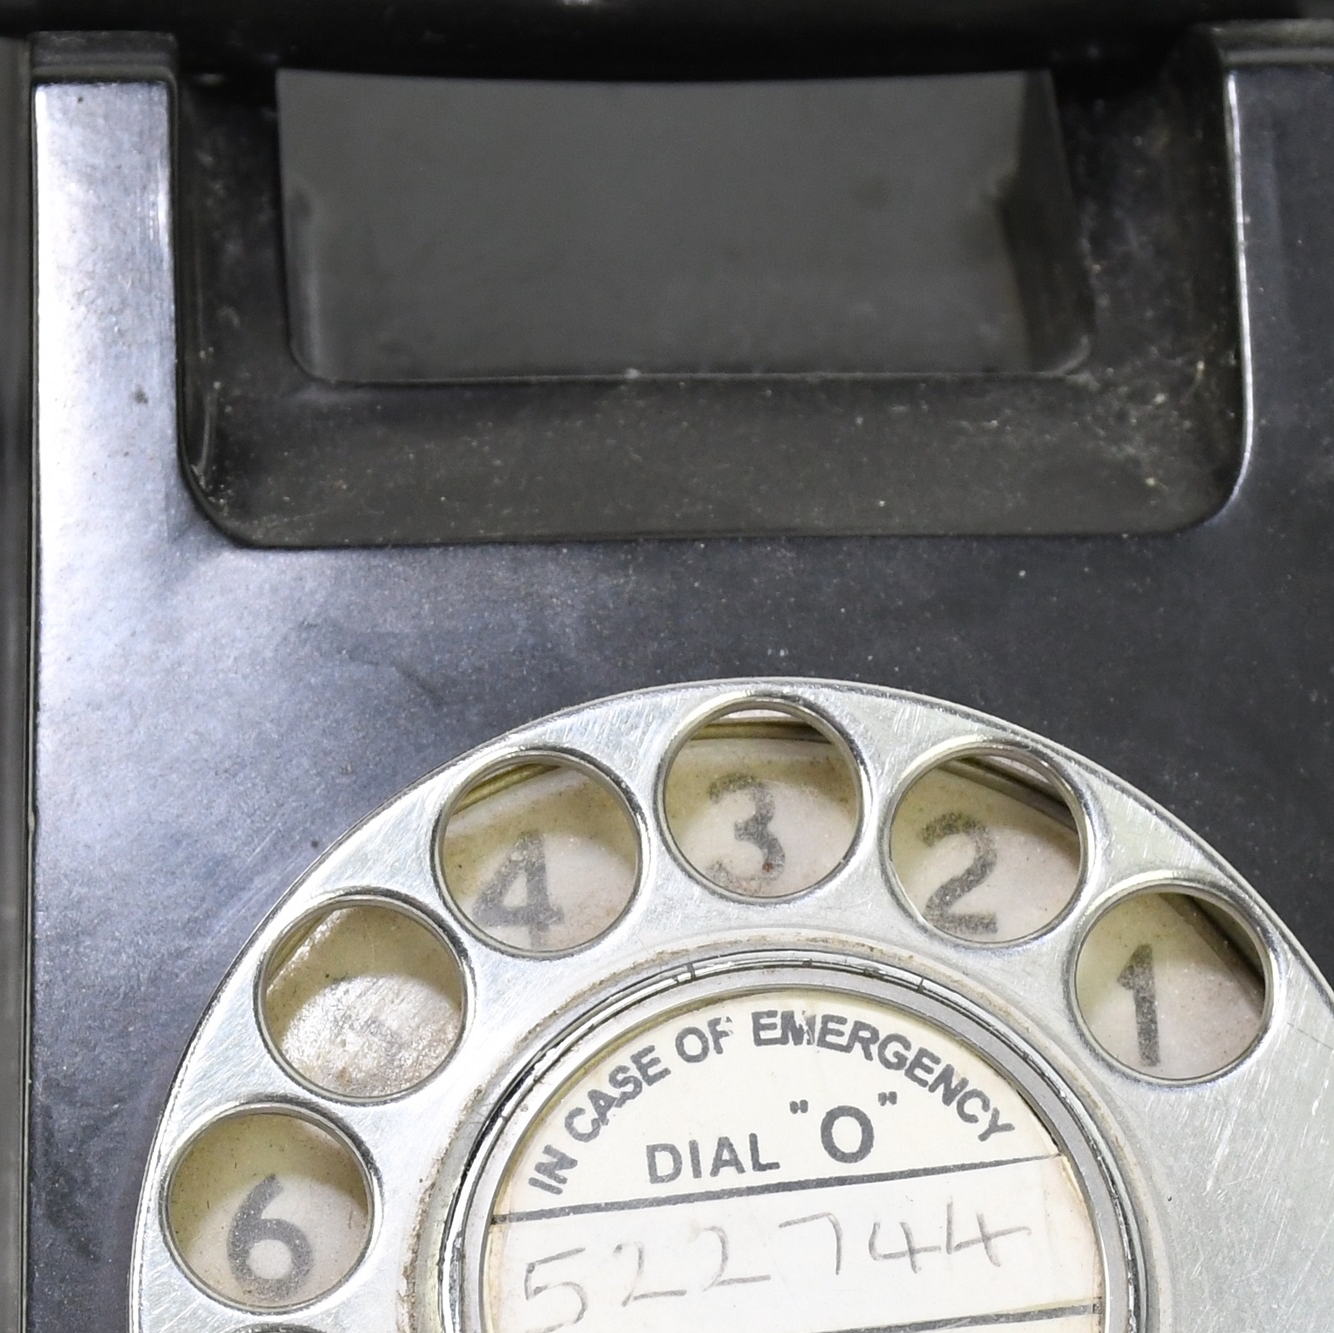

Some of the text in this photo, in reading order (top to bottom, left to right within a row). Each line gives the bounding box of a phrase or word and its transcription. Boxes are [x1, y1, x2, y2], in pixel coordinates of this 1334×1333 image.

[473, 827, 563, 948] 4
[708, 773, 786, 886] 3
[920, 814, 998, 935] 2
[1116, 943, 1161, 1068] 1
[528, 1009, 1016, 1195] IN CASE OF EMERGENCY
[646, 1133, 779, 1184] DIAL
[226, 1173, 313, 1297] 6
